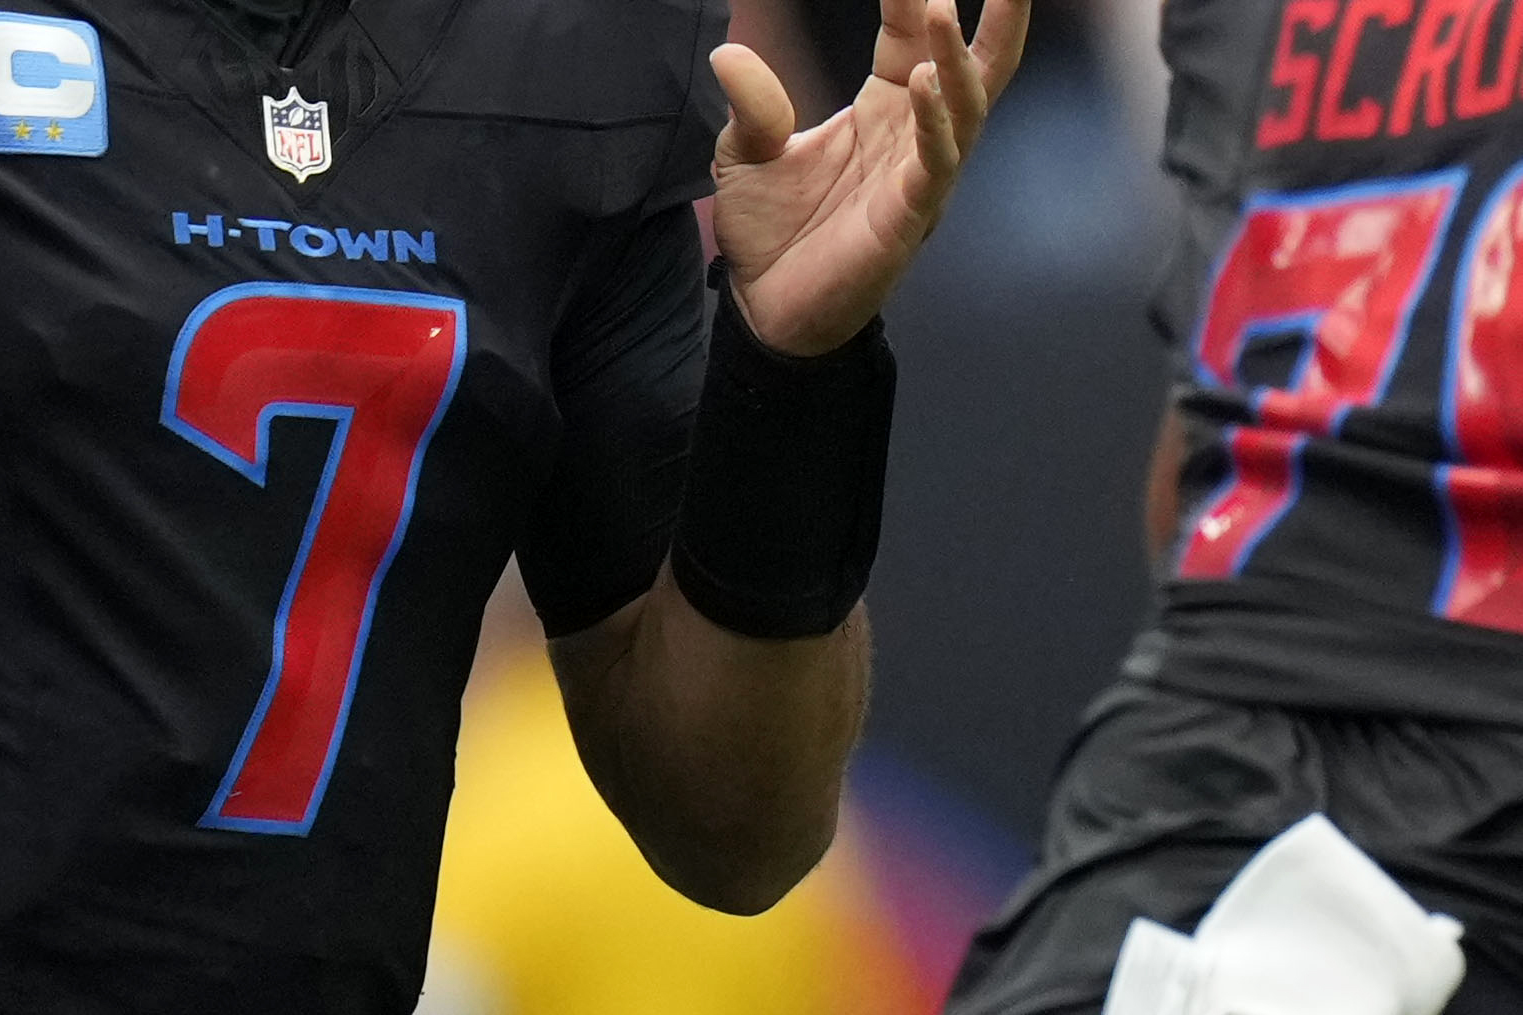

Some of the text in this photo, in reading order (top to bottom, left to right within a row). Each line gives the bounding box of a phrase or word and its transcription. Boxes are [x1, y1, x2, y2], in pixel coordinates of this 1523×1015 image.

[278, 130, 321, 164] NFL
[171, 211, 437, 264] H-TOWN
[159, 281, 467, 837] 7
